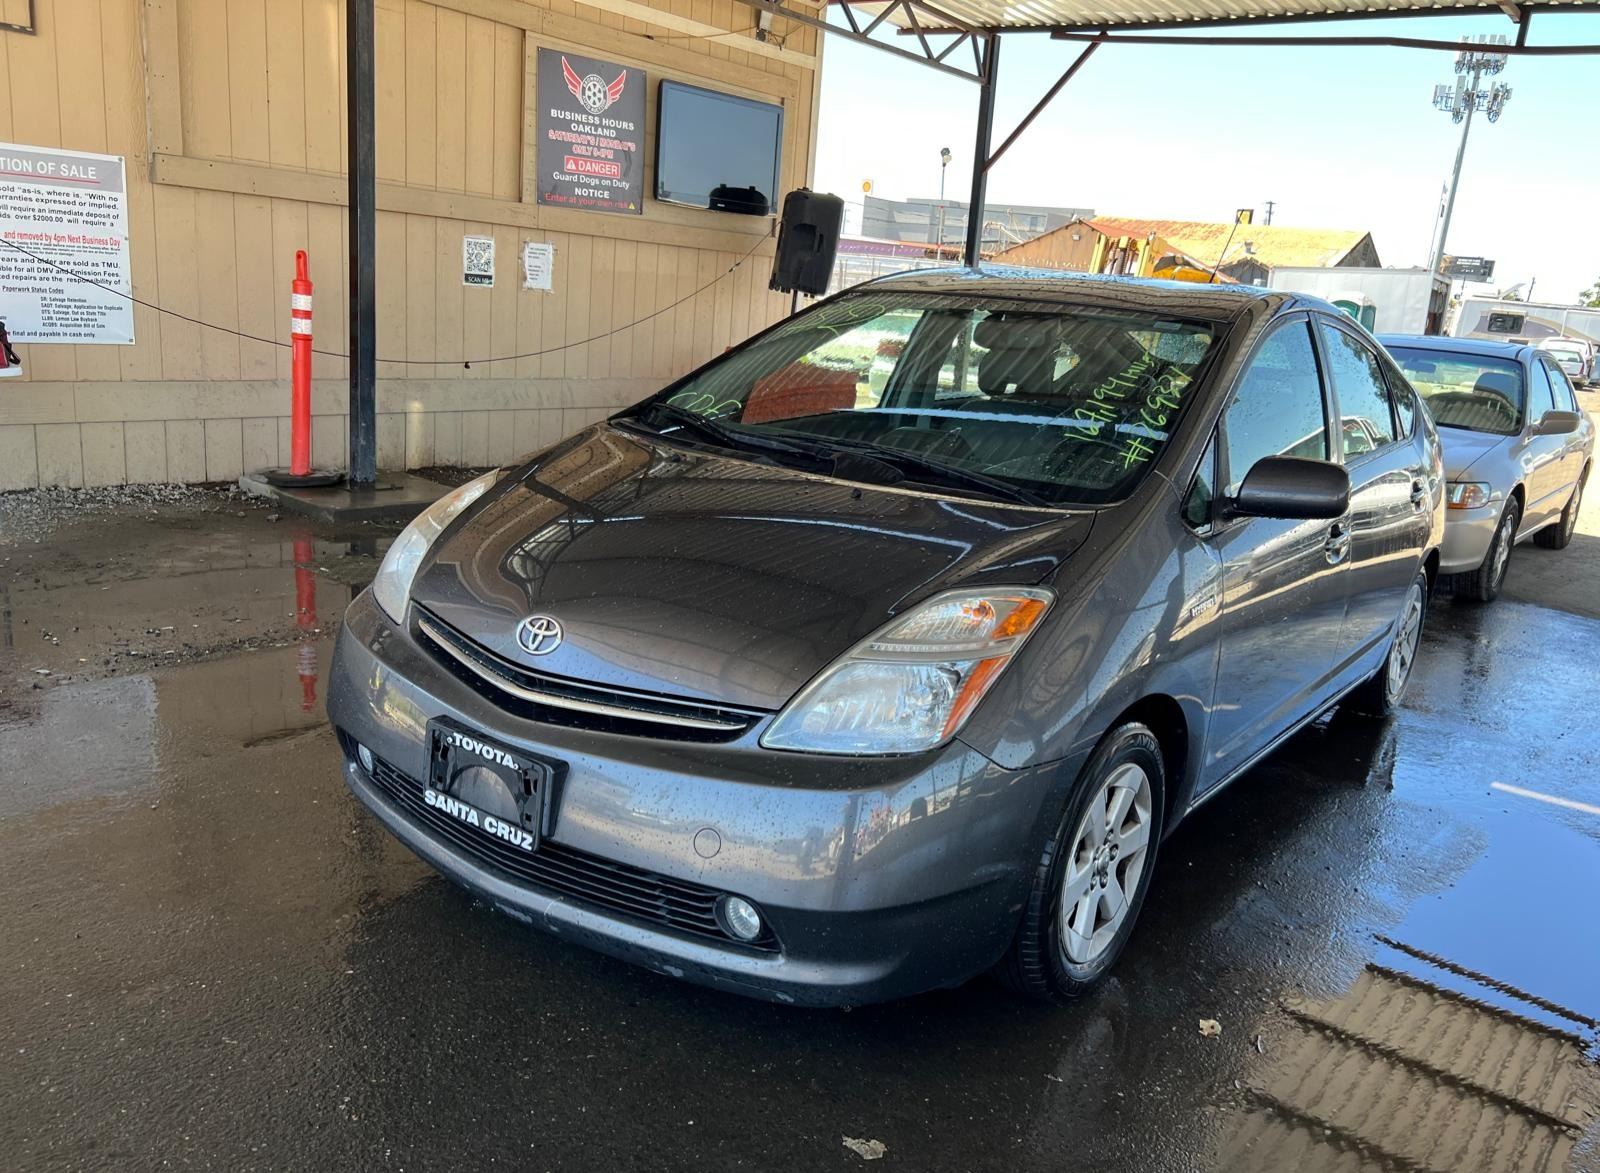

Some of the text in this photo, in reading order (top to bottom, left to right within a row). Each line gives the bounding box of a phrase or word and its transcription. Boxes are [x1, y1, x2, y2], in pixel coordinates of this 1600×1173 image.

[550, 109, 634, 130] BUSINESS HOURS
[571, 123, 616, 138] OAKLAND
[37, 161, 56, 174] OF
[60, 164, 96, 179] SALE
[578, 160, 618, 175] DANGER
[553, 172, 578, 182] Guard
[580, 174, 600, 186] Dogs
[612, 180, 630, 190] Duty
[544, 192, 567, 202] Enter
[574, 188, 610, 198] NOTICE
[36, 197, 76, 206] expressed
[10, 205, 36, 214] require
[48, 207, 84, 217] immediate
[86, 210, 110, 220] deposit
[82, 220, 106, 228] require
[4, 230, 16, 240] and
[16, 232, 44, 242] removed
[45, 233, 51, 243] by
[67, 234, 81, 244] Next
[82, 236, 108, 246] Business
[110, 238, 120, 248] Day
[452, 732, 514, 769] TOYOTA
[424, 790, 533, 850] SANTA CRUZ
